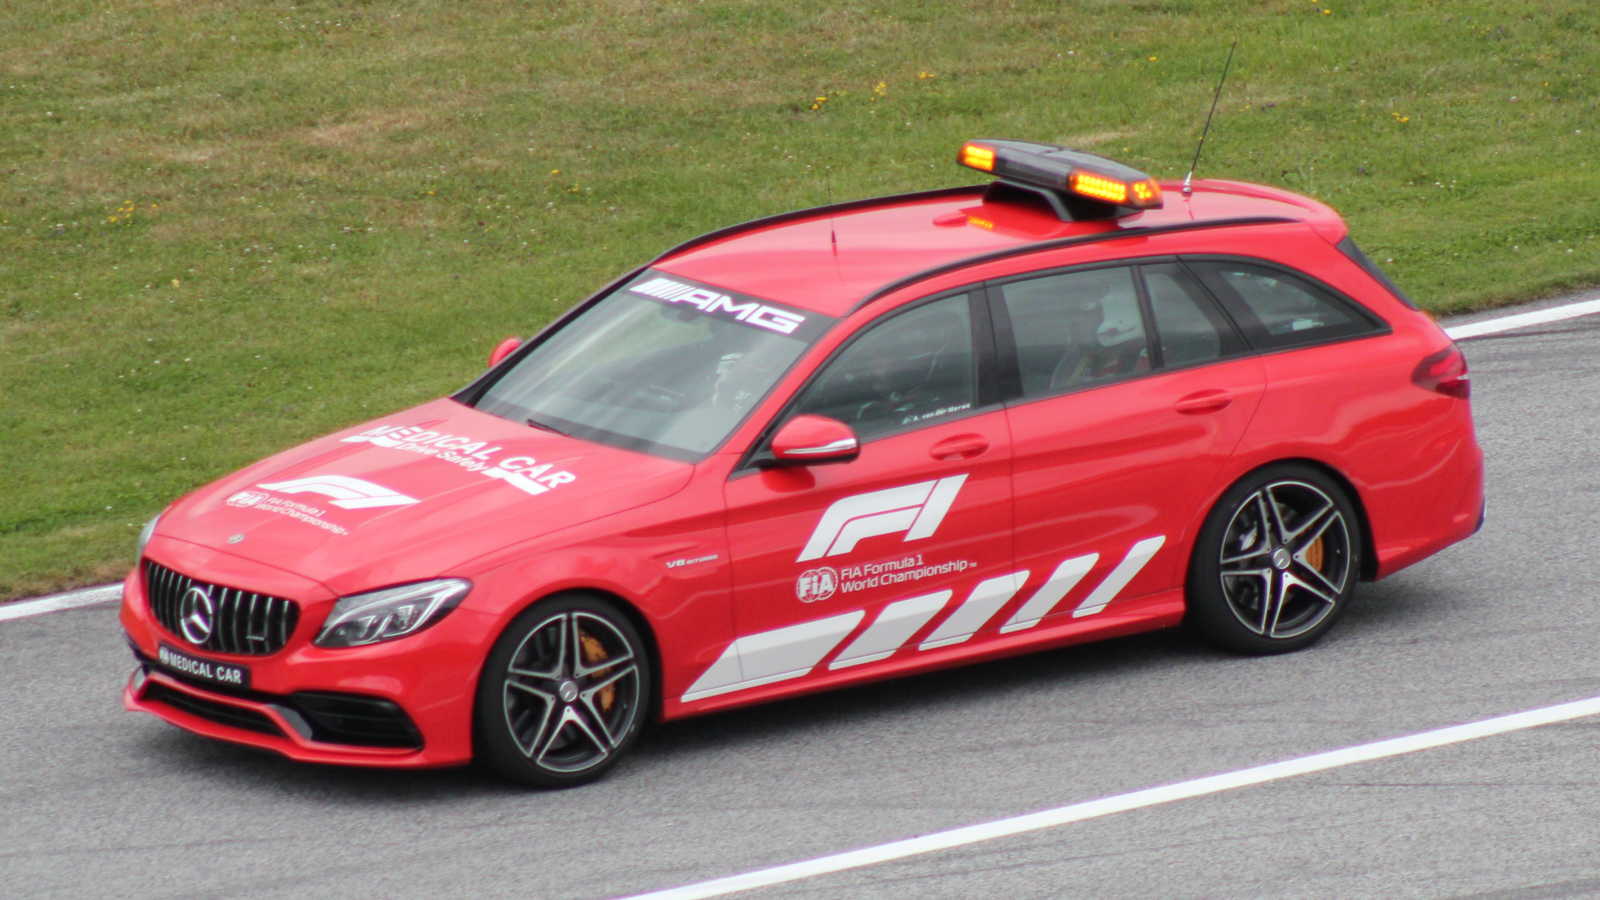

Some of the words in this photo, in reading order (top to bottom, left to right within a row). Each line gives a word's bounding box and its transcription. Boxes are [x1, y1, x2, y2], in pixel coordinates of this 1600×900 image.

[670, 288, 806, 334] AMG
[361, 425, 503, 460] MEDICAL
[499, 456, 576, 488] CAR
[841, 567, 862, 580] FIA
[863, 555, 914, 576] Formula
[914, 553, 924, 567] 1
[841, 574, 879, 593] World
[880, 560, 968, 585] Championship
[169, 651, 213, 679] MEDICAL
[216, 665, 242, 684] CAR
